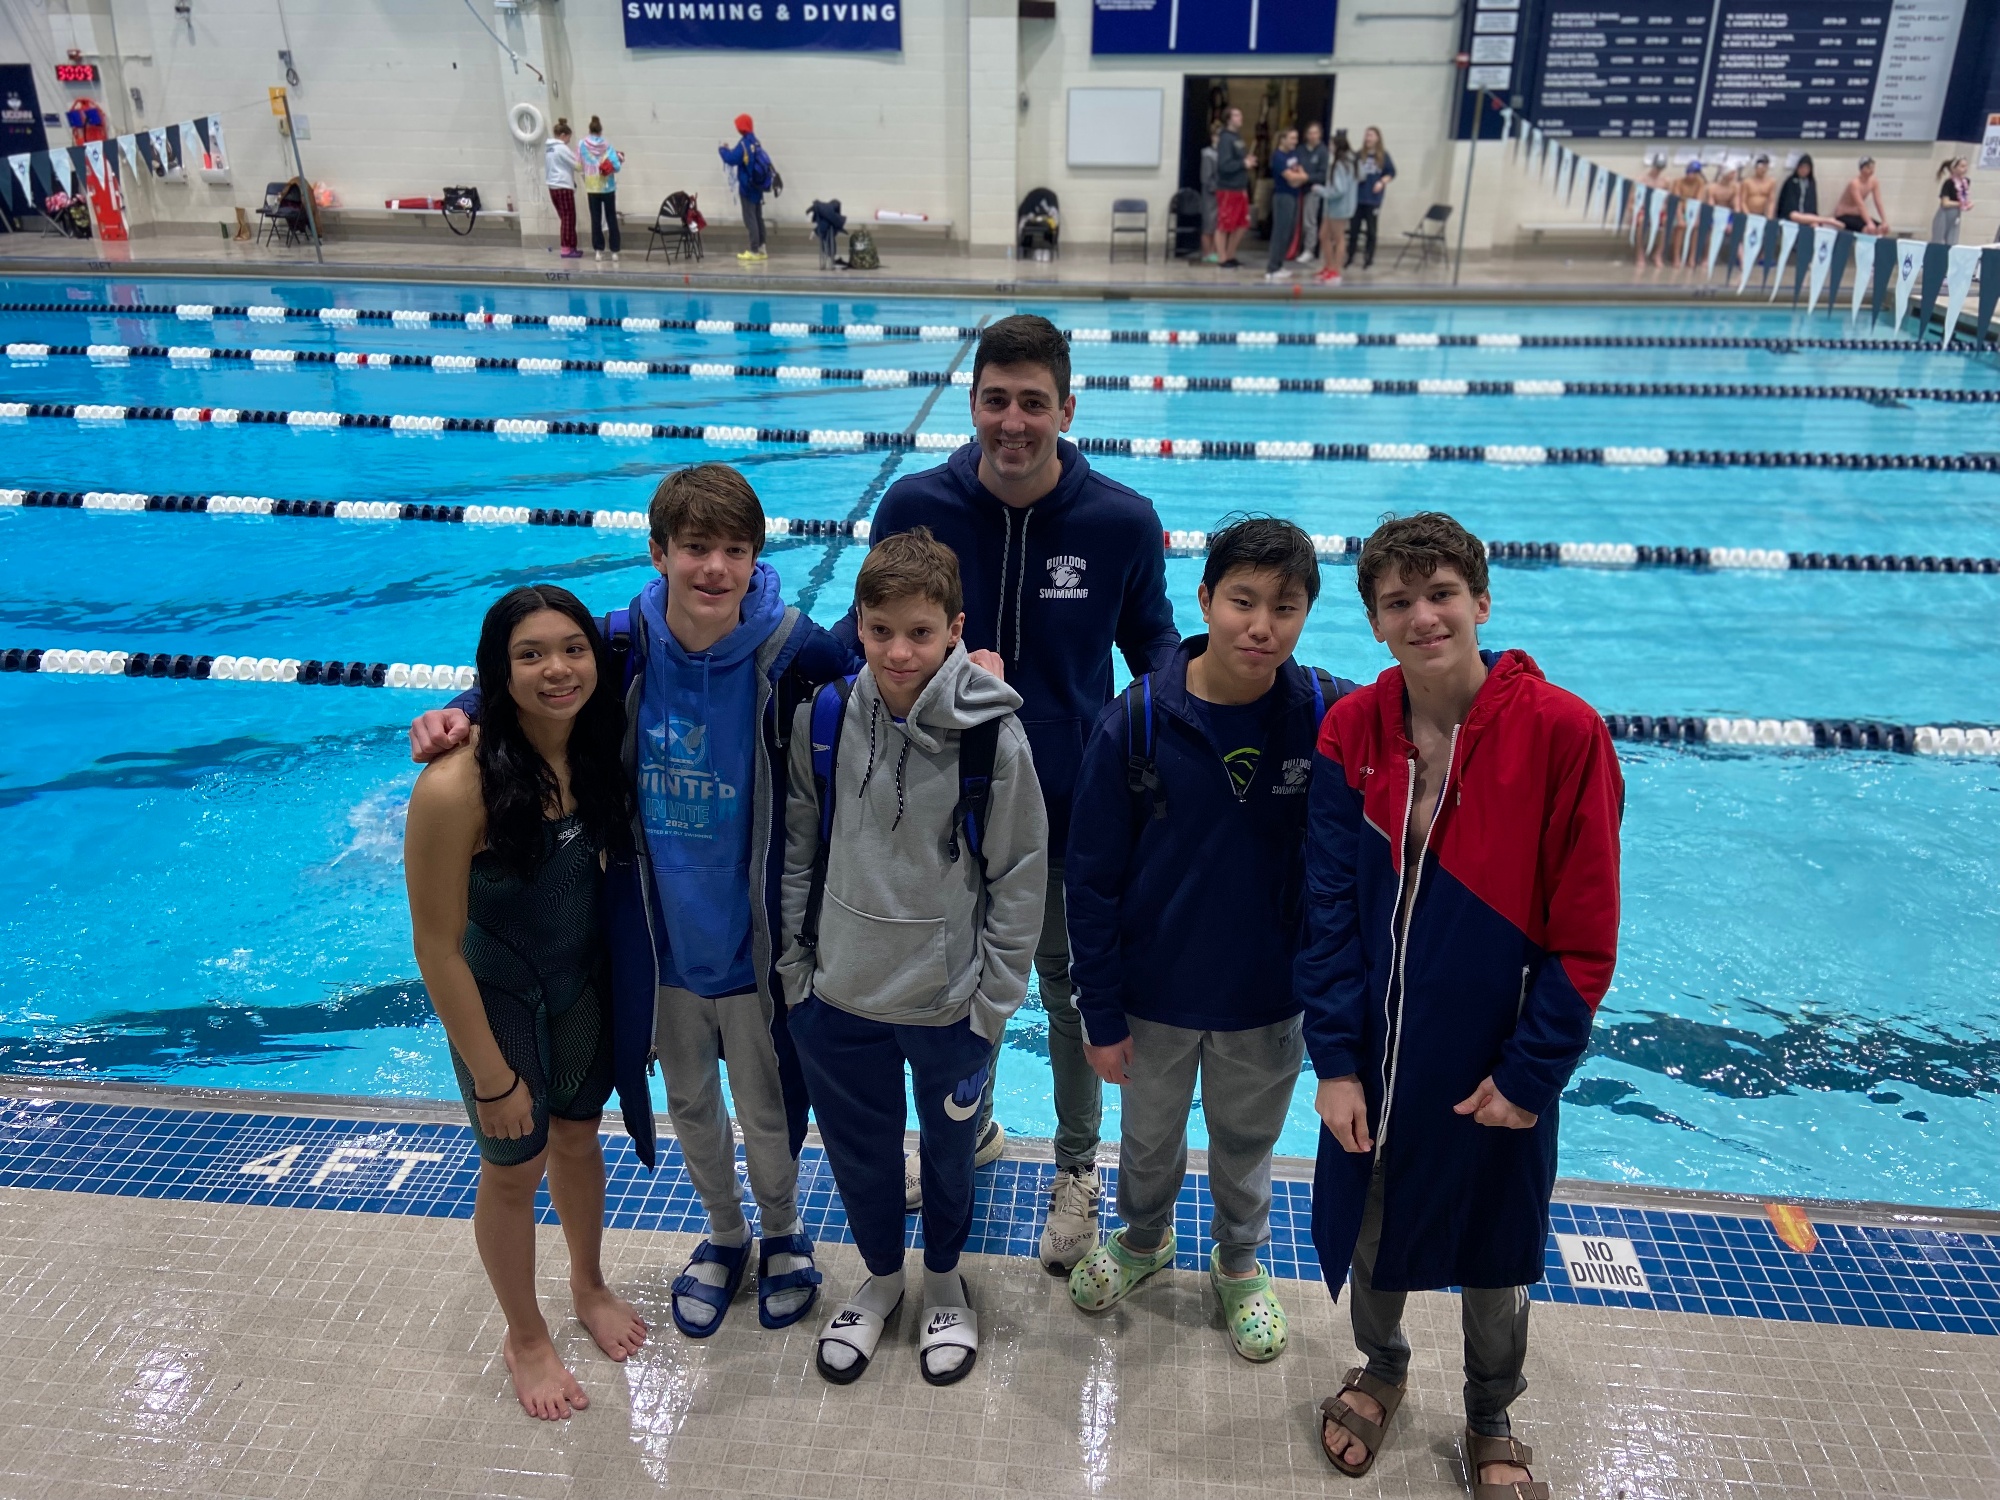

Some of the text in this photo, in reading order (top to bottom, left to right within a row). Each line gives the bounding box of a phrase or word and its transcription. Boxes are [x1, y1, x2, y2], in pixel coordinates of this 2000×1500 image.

[627, 2, 896, 22] SWIMMING & DIVING
[1, 110, 33, 120] UCONN
[1046, 555, 1087, 571] BULLDOG
[1039, 588, 1089, 599] SWIMMING
[645, 797, 710, 824] INVITE
[665, 819, 689, 830] 2022
[1582, 1240, 1614, 1262] NO
[1570, 1261, 1644, 1287] DIVING
[837, 1310, 864, 1324] NIKE
[933, 1312, 959, 1325] NIKE
